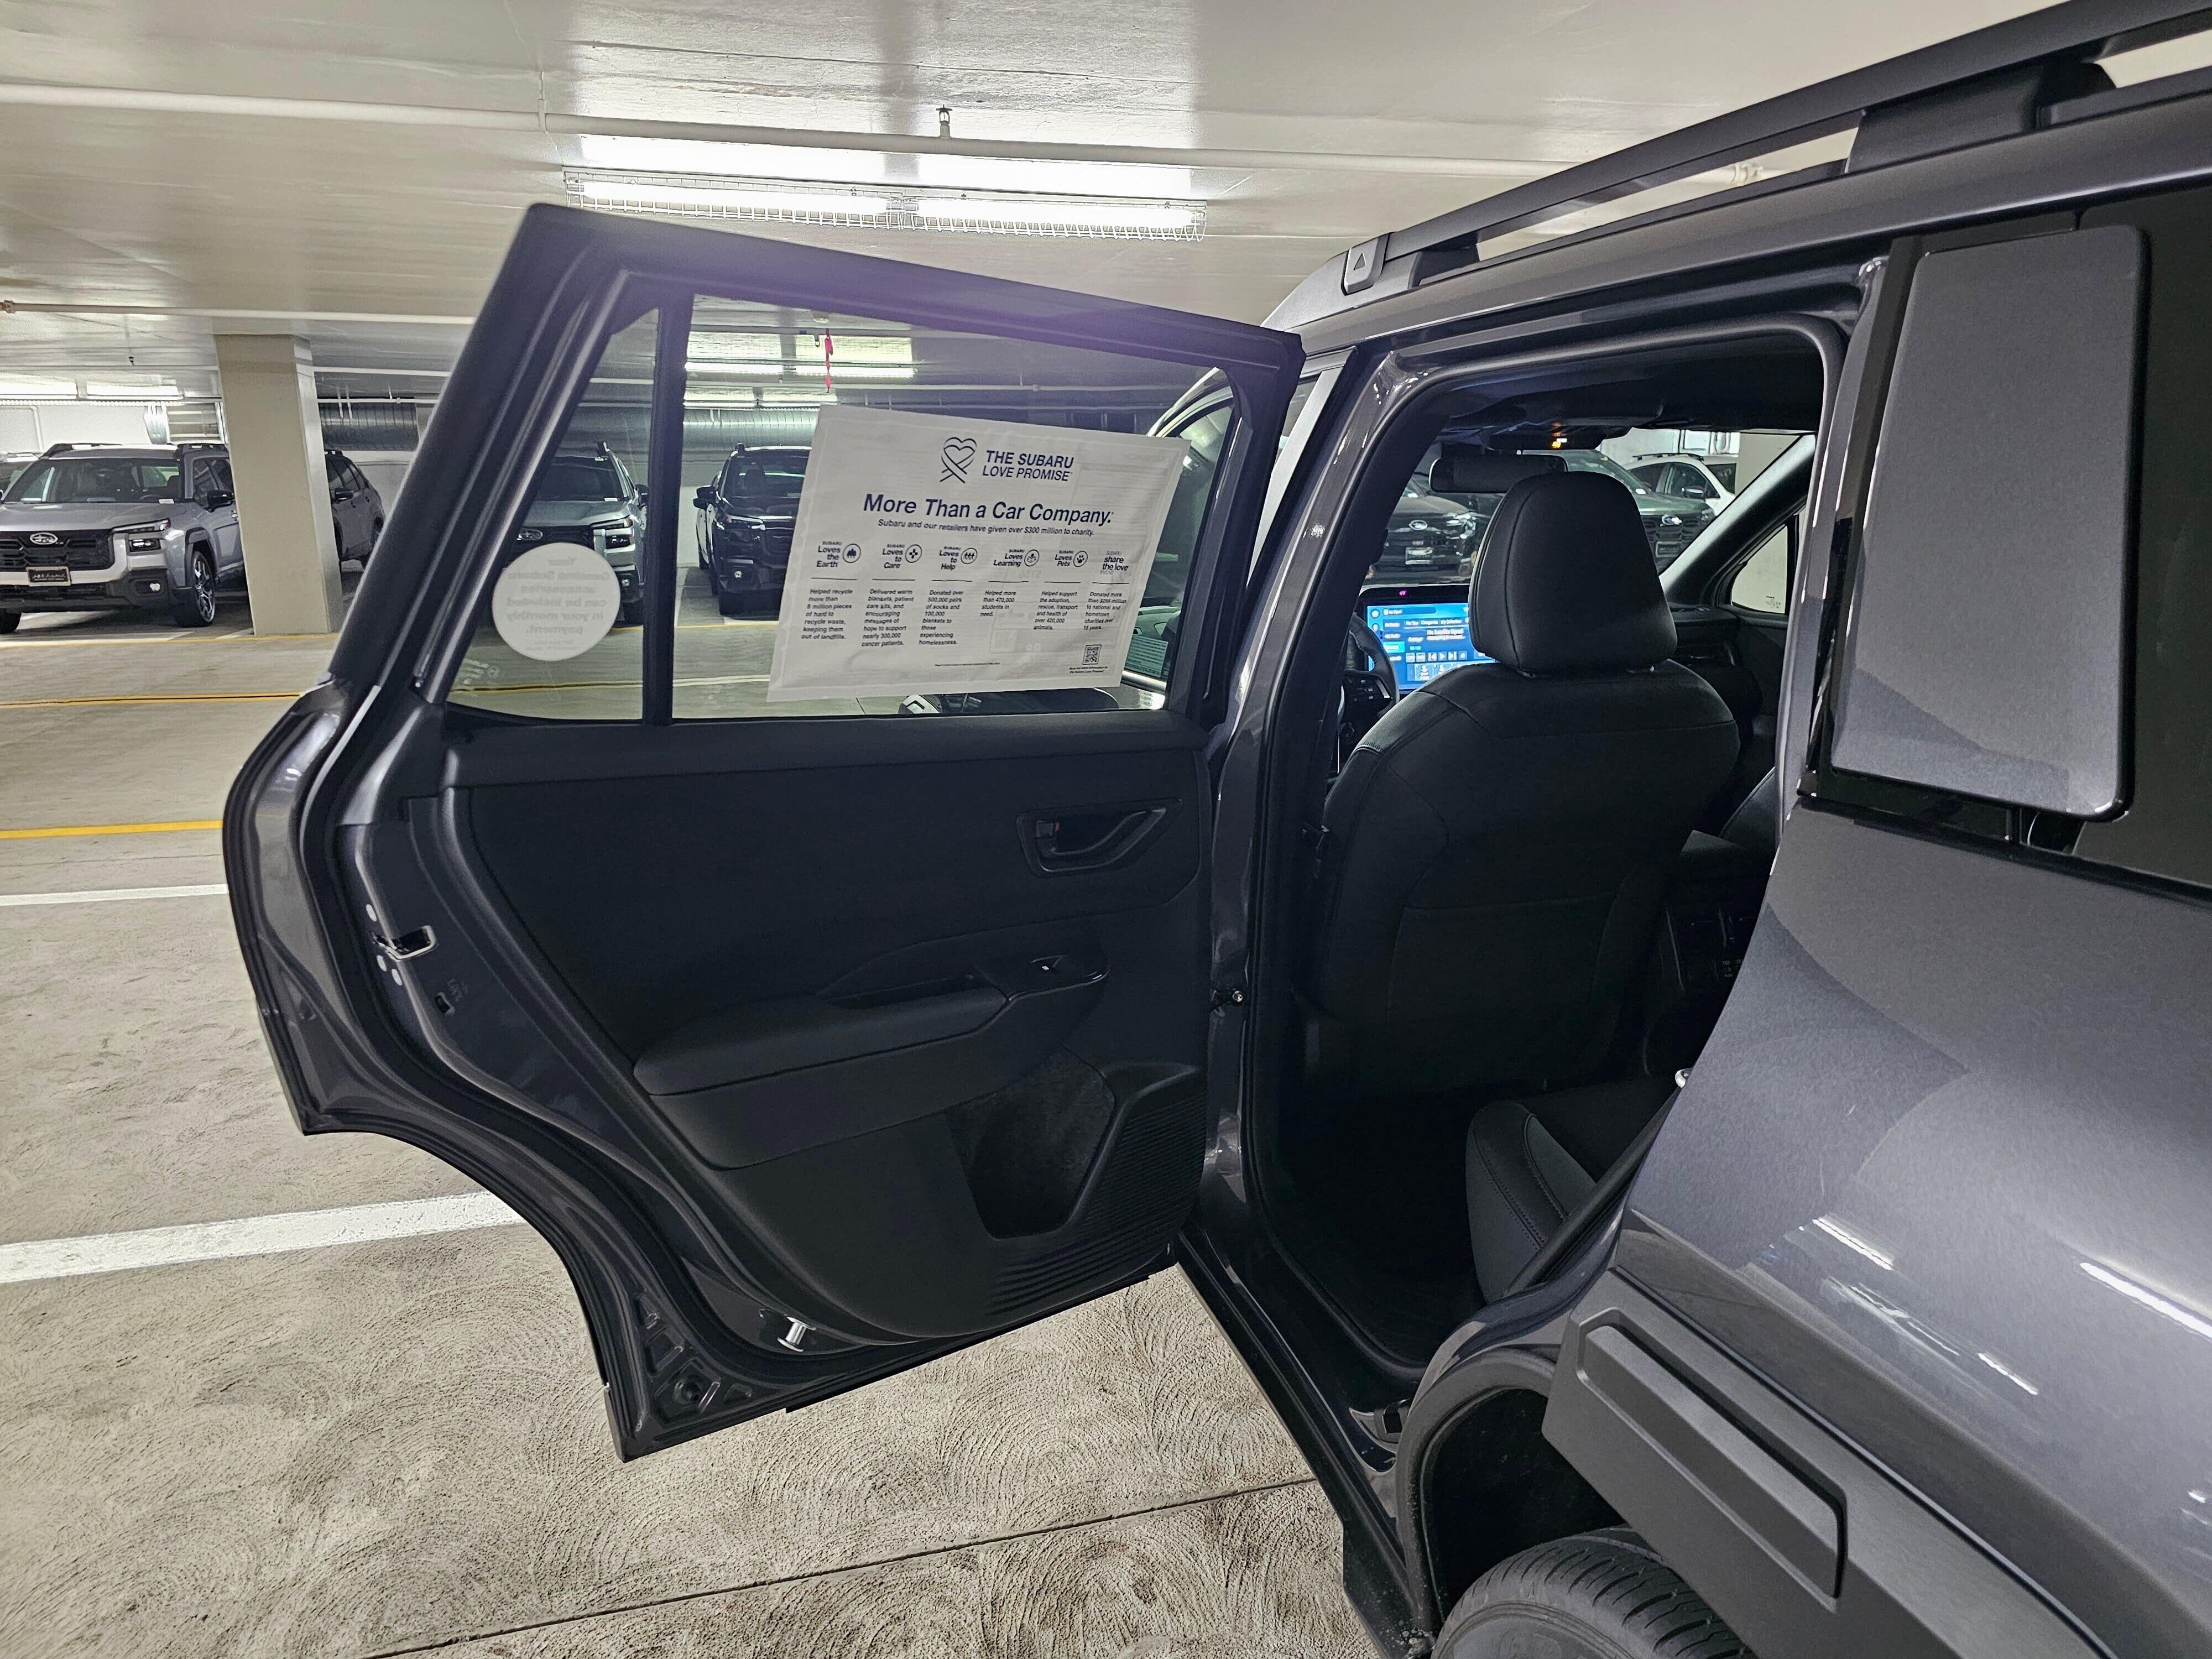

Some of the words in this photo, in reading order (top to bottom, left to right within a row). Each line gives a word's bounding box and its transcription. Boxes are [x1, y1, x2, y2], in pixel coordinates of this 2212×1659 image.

[986, 450, 1014, 465] THE
[1018, 453, 1074, 468] SUBARU
[982, 466, 1014, 478] LOVE
[1016, 469, 1073, 481] PROMISE
[863, 493, 917, 514] More
[925, 499, 970, 518] Than
[975, 505, 986, 518] a
[992, 502, 1025, 520] Car
[878, 519, 905, 528] Subaru
[938, 523, 968, 532] retailers
[987, 526, 1006, 534] given
[1041, 526, 1062, 535] million
[1071, 528, 1094, 537] charity.
